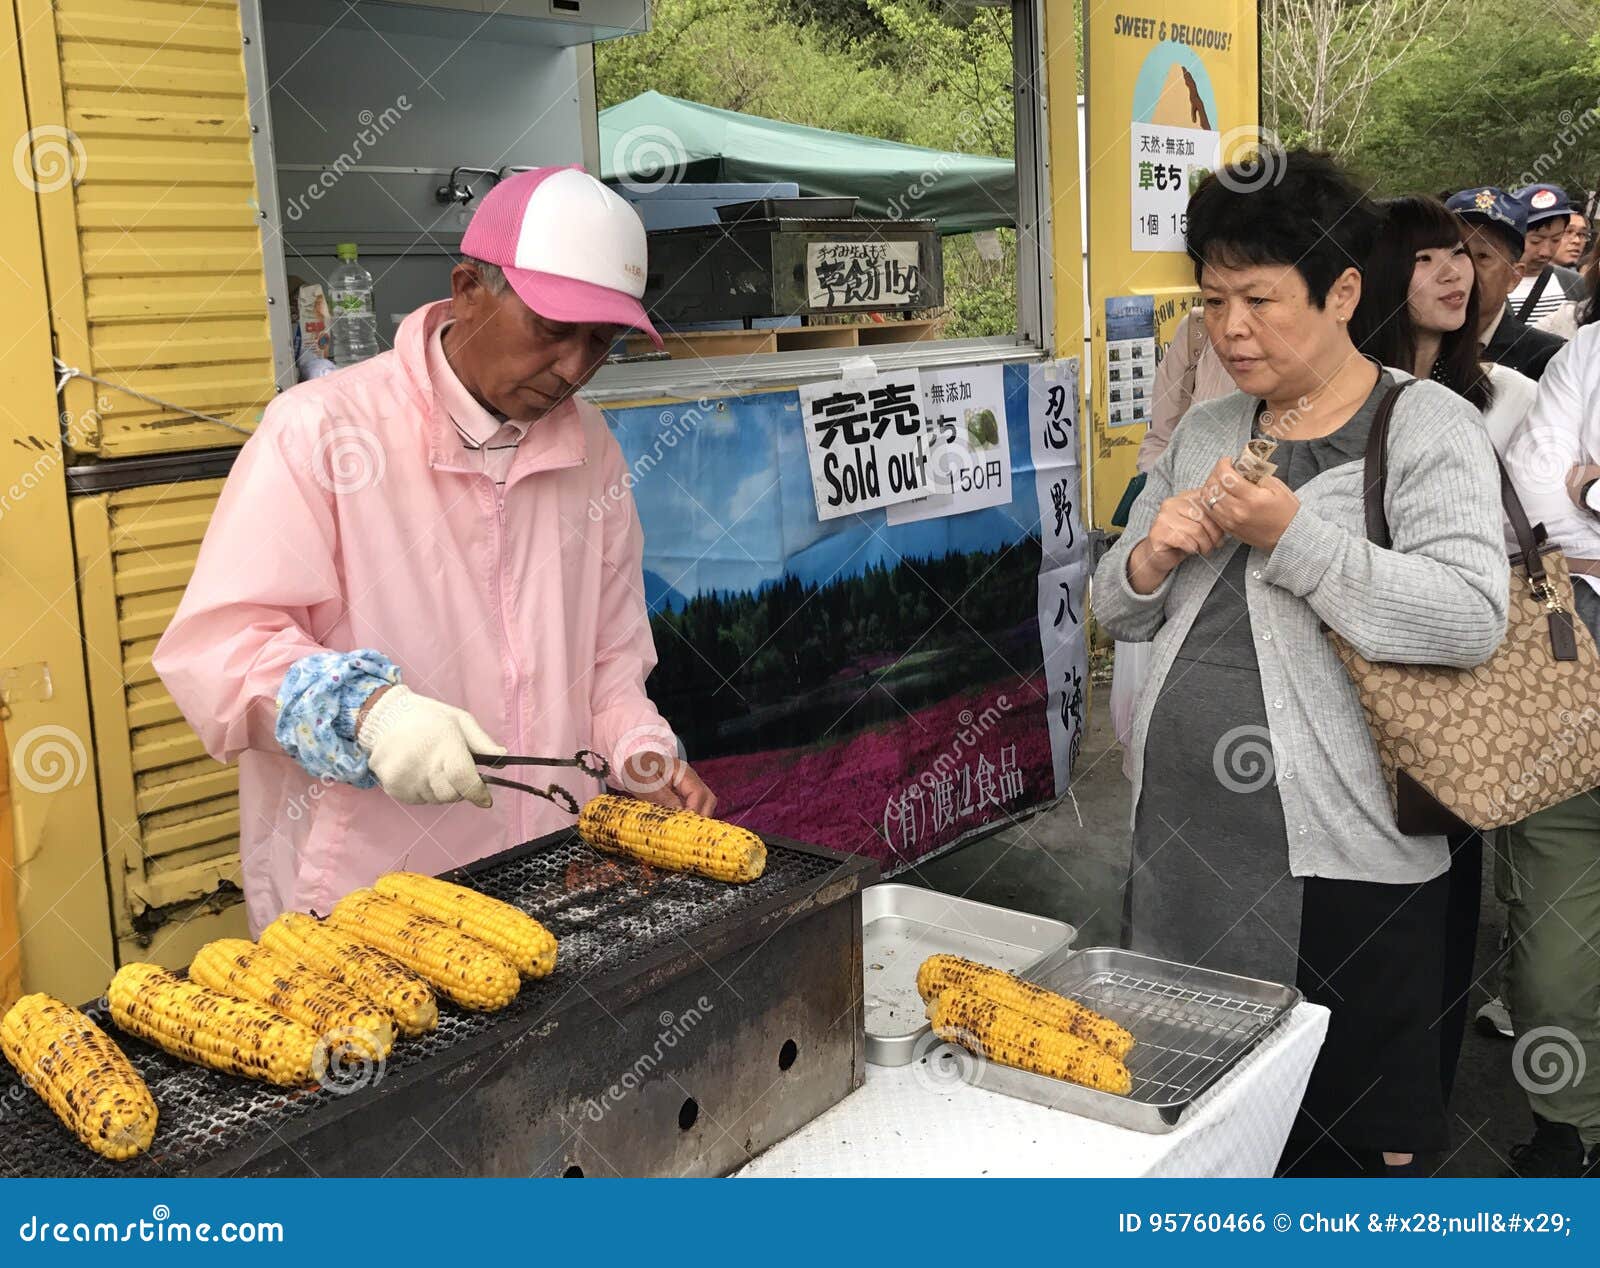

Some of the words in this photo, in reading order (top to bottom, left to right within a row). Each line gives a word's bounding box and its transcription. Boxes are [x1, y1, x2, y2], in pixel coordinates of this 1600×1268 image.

[1114, 14, 1156, 40] SWEET
[1158, 21, 1167, 41] &
[1170, 23, 1232, 51] DELICIOUS!
[1138, 160, 1182, 191] 草もち
[1139, 213, 1159, 236] 1個
[811, 383, 921, 449] 完売
[823, 445, 881, 507] Sold
[888, 435, 928, 494] out
[946, 460, 1002, 494] 150円
